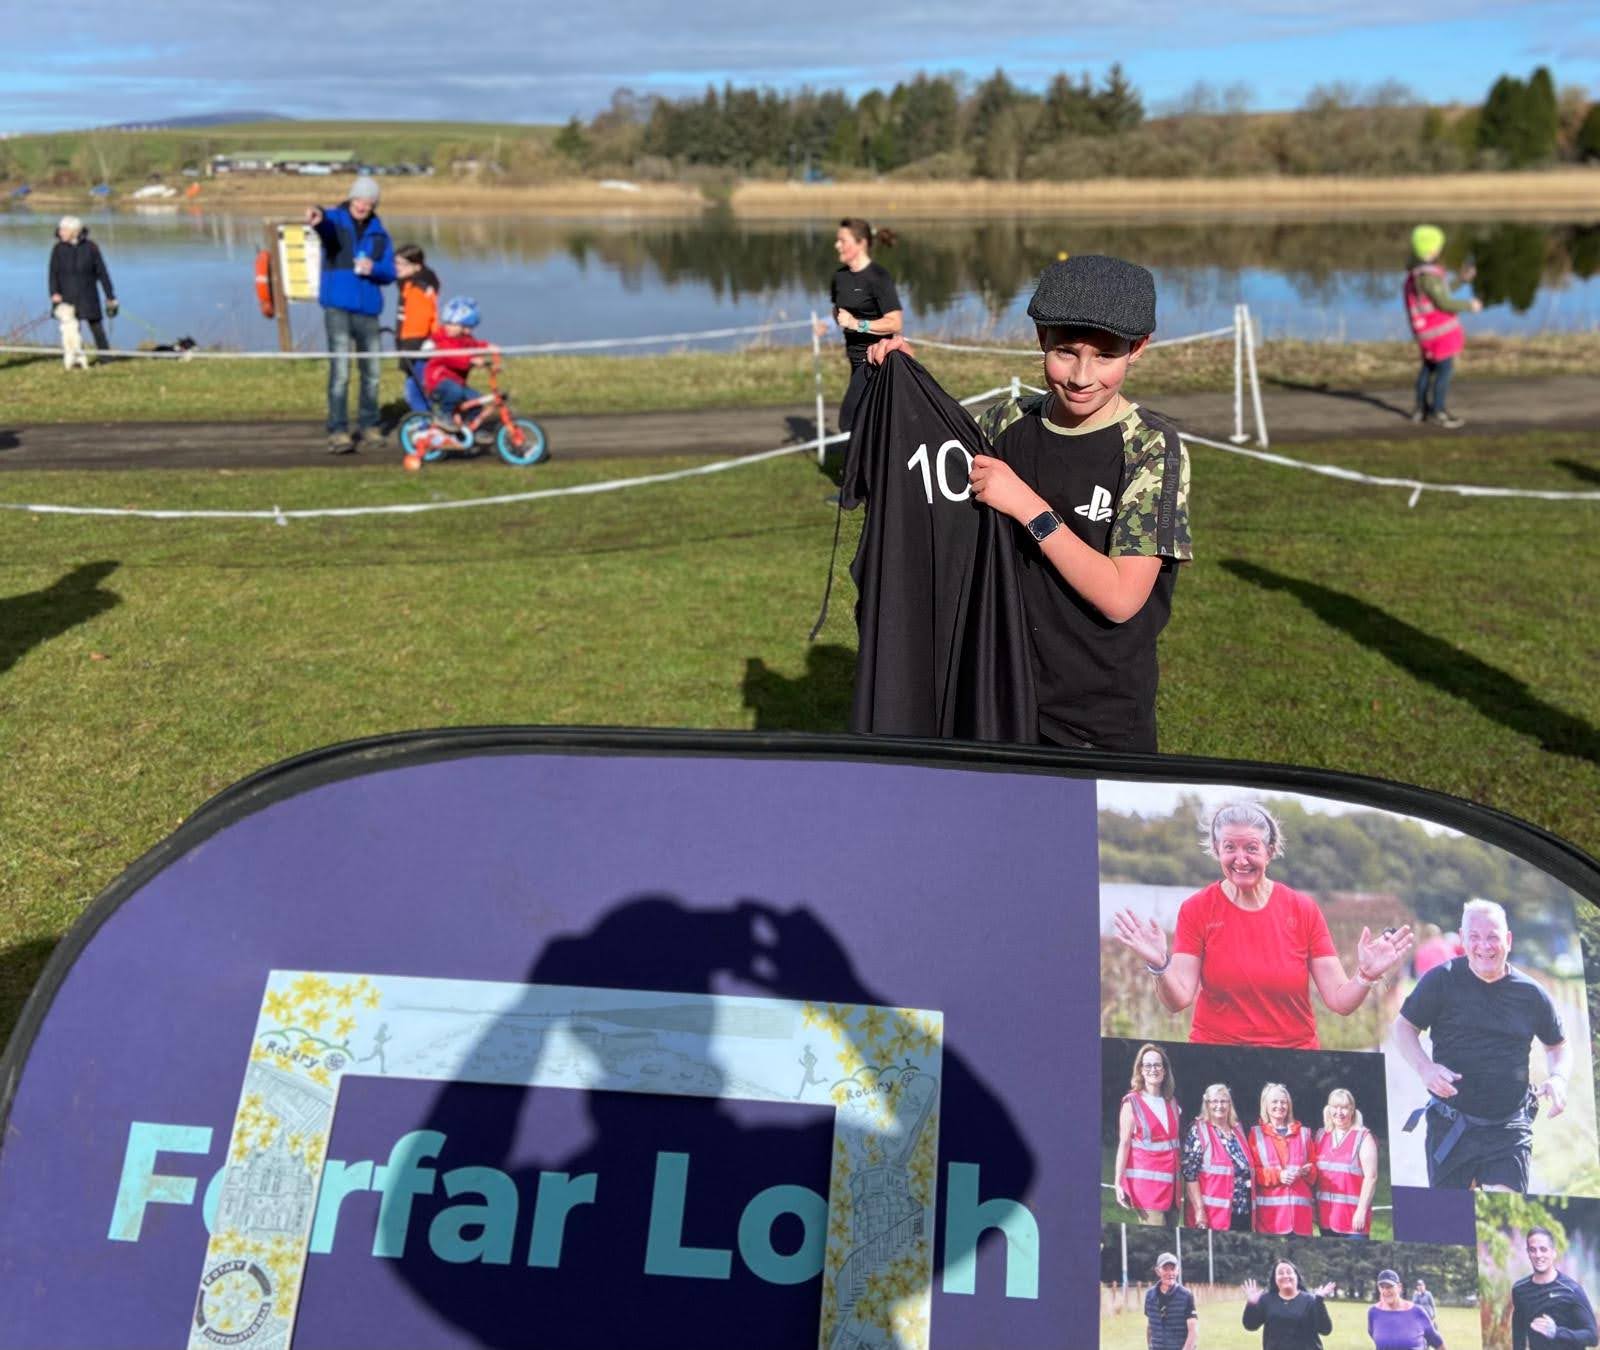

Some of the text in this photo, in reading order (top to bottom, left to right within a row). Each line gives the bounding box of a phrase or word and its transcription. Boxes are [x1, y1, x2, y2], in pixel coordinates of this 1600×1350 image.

[907, 439, 973, 503] 10
[266, 1040, 319, 1068] Rotary
[846, 1081, 894, 1101] Rotary
[107, 1121, 1039, 1299] Frfar Loh
